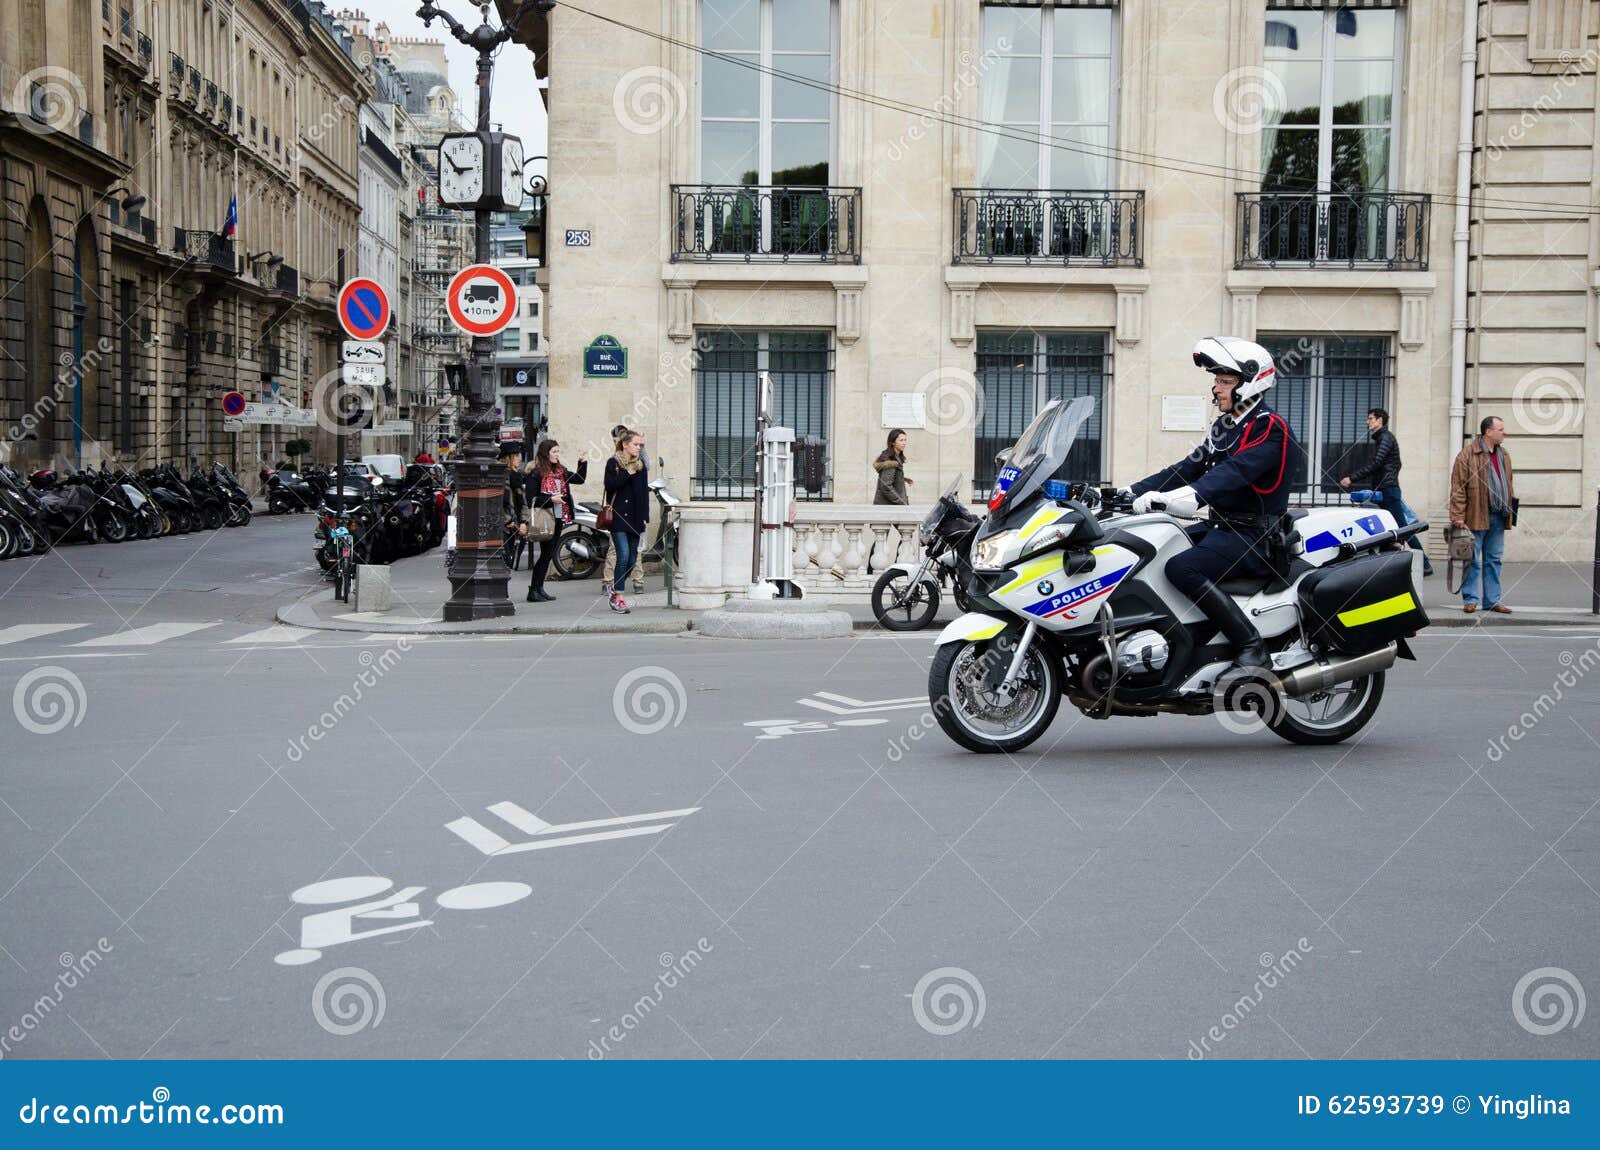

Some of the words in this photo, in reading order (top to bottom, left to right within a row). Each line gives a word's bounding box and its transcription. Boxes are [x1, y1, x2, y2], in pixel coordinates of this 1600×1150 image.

[567, 230, 590, 246] 258
[1340, 527, 1353, 538] 17
[1052, 579, 1103, 609] POLICE
